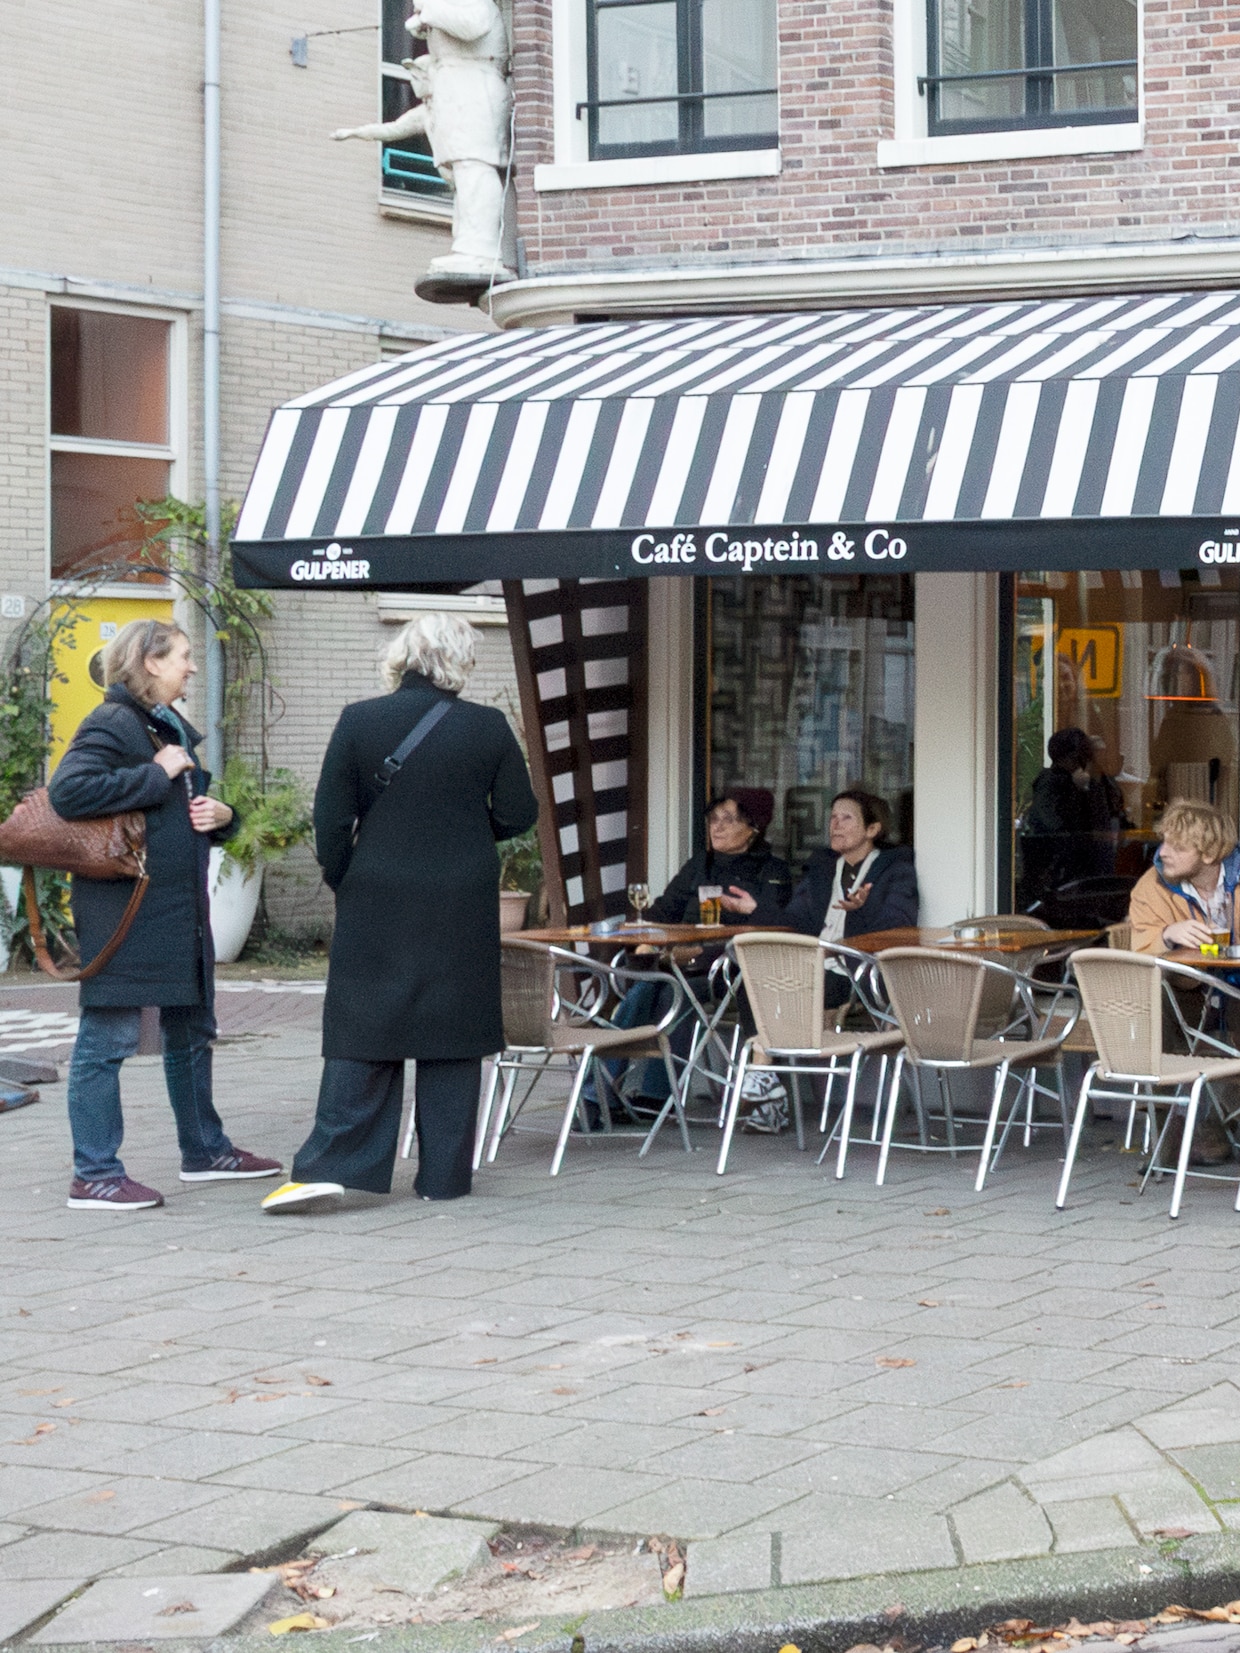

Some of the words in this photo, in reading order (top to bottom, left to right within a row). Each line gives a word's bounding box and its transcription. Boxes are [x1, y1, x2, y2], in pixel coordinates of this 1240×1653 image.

[631, 533, 696, 564] Café
[705, 530, 819, 571] Captein
[827, 531, 855, 561] &
[864, 529, 907, 560] Co
[290, 560, 371, 581] GULPENER
